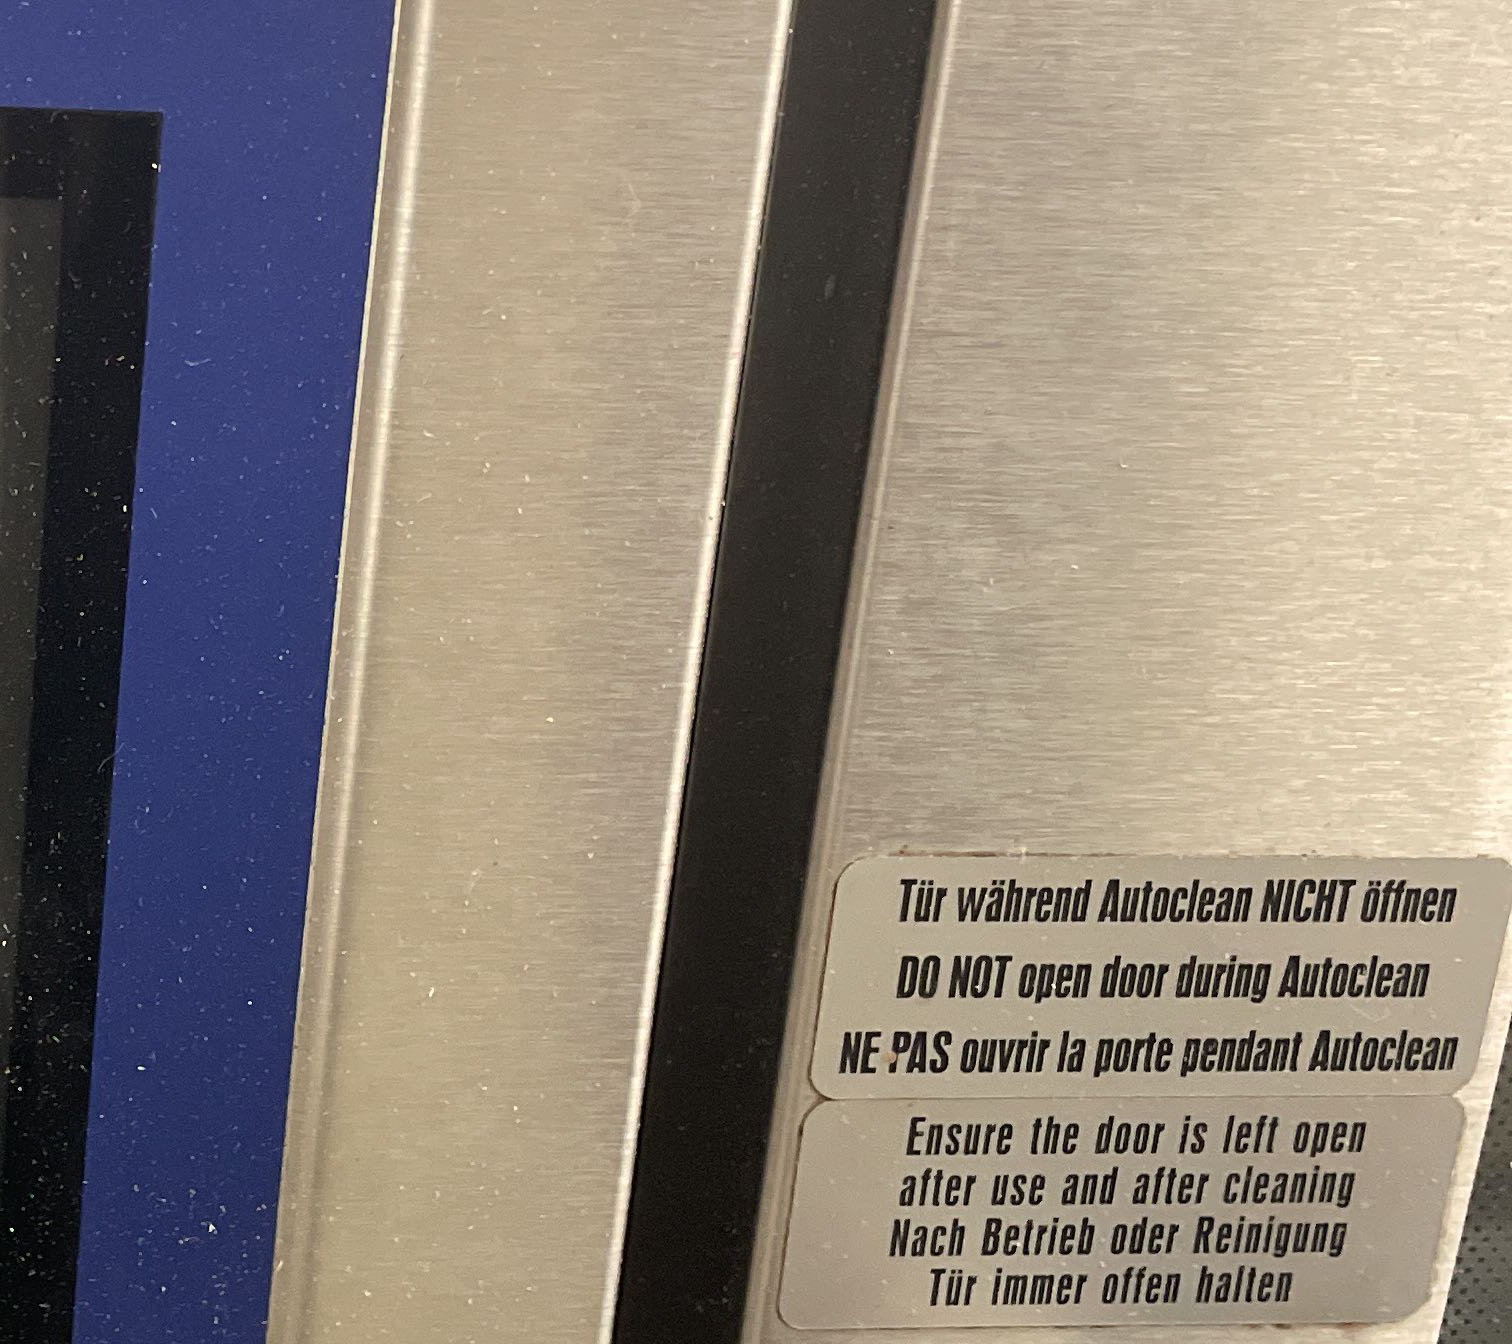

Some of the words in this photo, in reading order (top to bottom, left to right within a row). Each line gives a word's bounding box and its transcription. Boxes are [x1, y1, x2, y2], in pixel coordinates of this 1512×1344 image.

[898, 879, 946, 923] Tür
[957, 879, 1091, 923] während
[1098, 879, 1252, 923] Autoclean
[1260, 879, 1356, 923] NICHT
[1360, 879, 1458, 923] öffnen
[896, 956, 940, 1000] DO
[949, 956, 1011, 1000] NOT
[1018, 963, 1092, 1003] open
[1099, 957, 1171, 998] door
[1176, 957, 1273, 1003] during
[1278, 956, 1430, 999] Autoclean
[839, 1031, 881, 1074] NE
[889, 1031, 953, 1074] PAS
[961, 1032, 1049, 1073] ouvrir
[1056, 1032, 1085, 1073] la
[1094, 1035, 1174, 1077] porte
[1181, 1031, 1300, 1077] pendant
[1309, 1030, 1459, 1072] Autoclean
[906, 1117, 1013, 1156] Ensure
[1031, 1117, 1079, 1155] the
[1095, 1116, 1165, 1154] door
[1180, 1117, 1208, 1154] is
[1223, 1116, 1279, 1154] left
[1293, 1121, 1367, 1157] open
[898, 1168, 977, 1207] after
[992, 1175, 1045, 1206] use
[1062, 1167, 1118, 1206] and
[1132, 1167, 1209, 1206] after
[1223, 1166, 1356, 1208] cleaning
[889, 1219, 965, 1257] Nach
[981, 1218, 1095, 1256] Betrieb
[1111, 1218, 1179, 1256] oder
[1193, 1217, 1347, 1258] Reinigung
[929, 1268, 977, 1307] Tür
[992, 1268, 1087, 1305] immer
[1103, 1267, 1180, 1305] offen
[1196, 1267, 1293, 1303] halten
